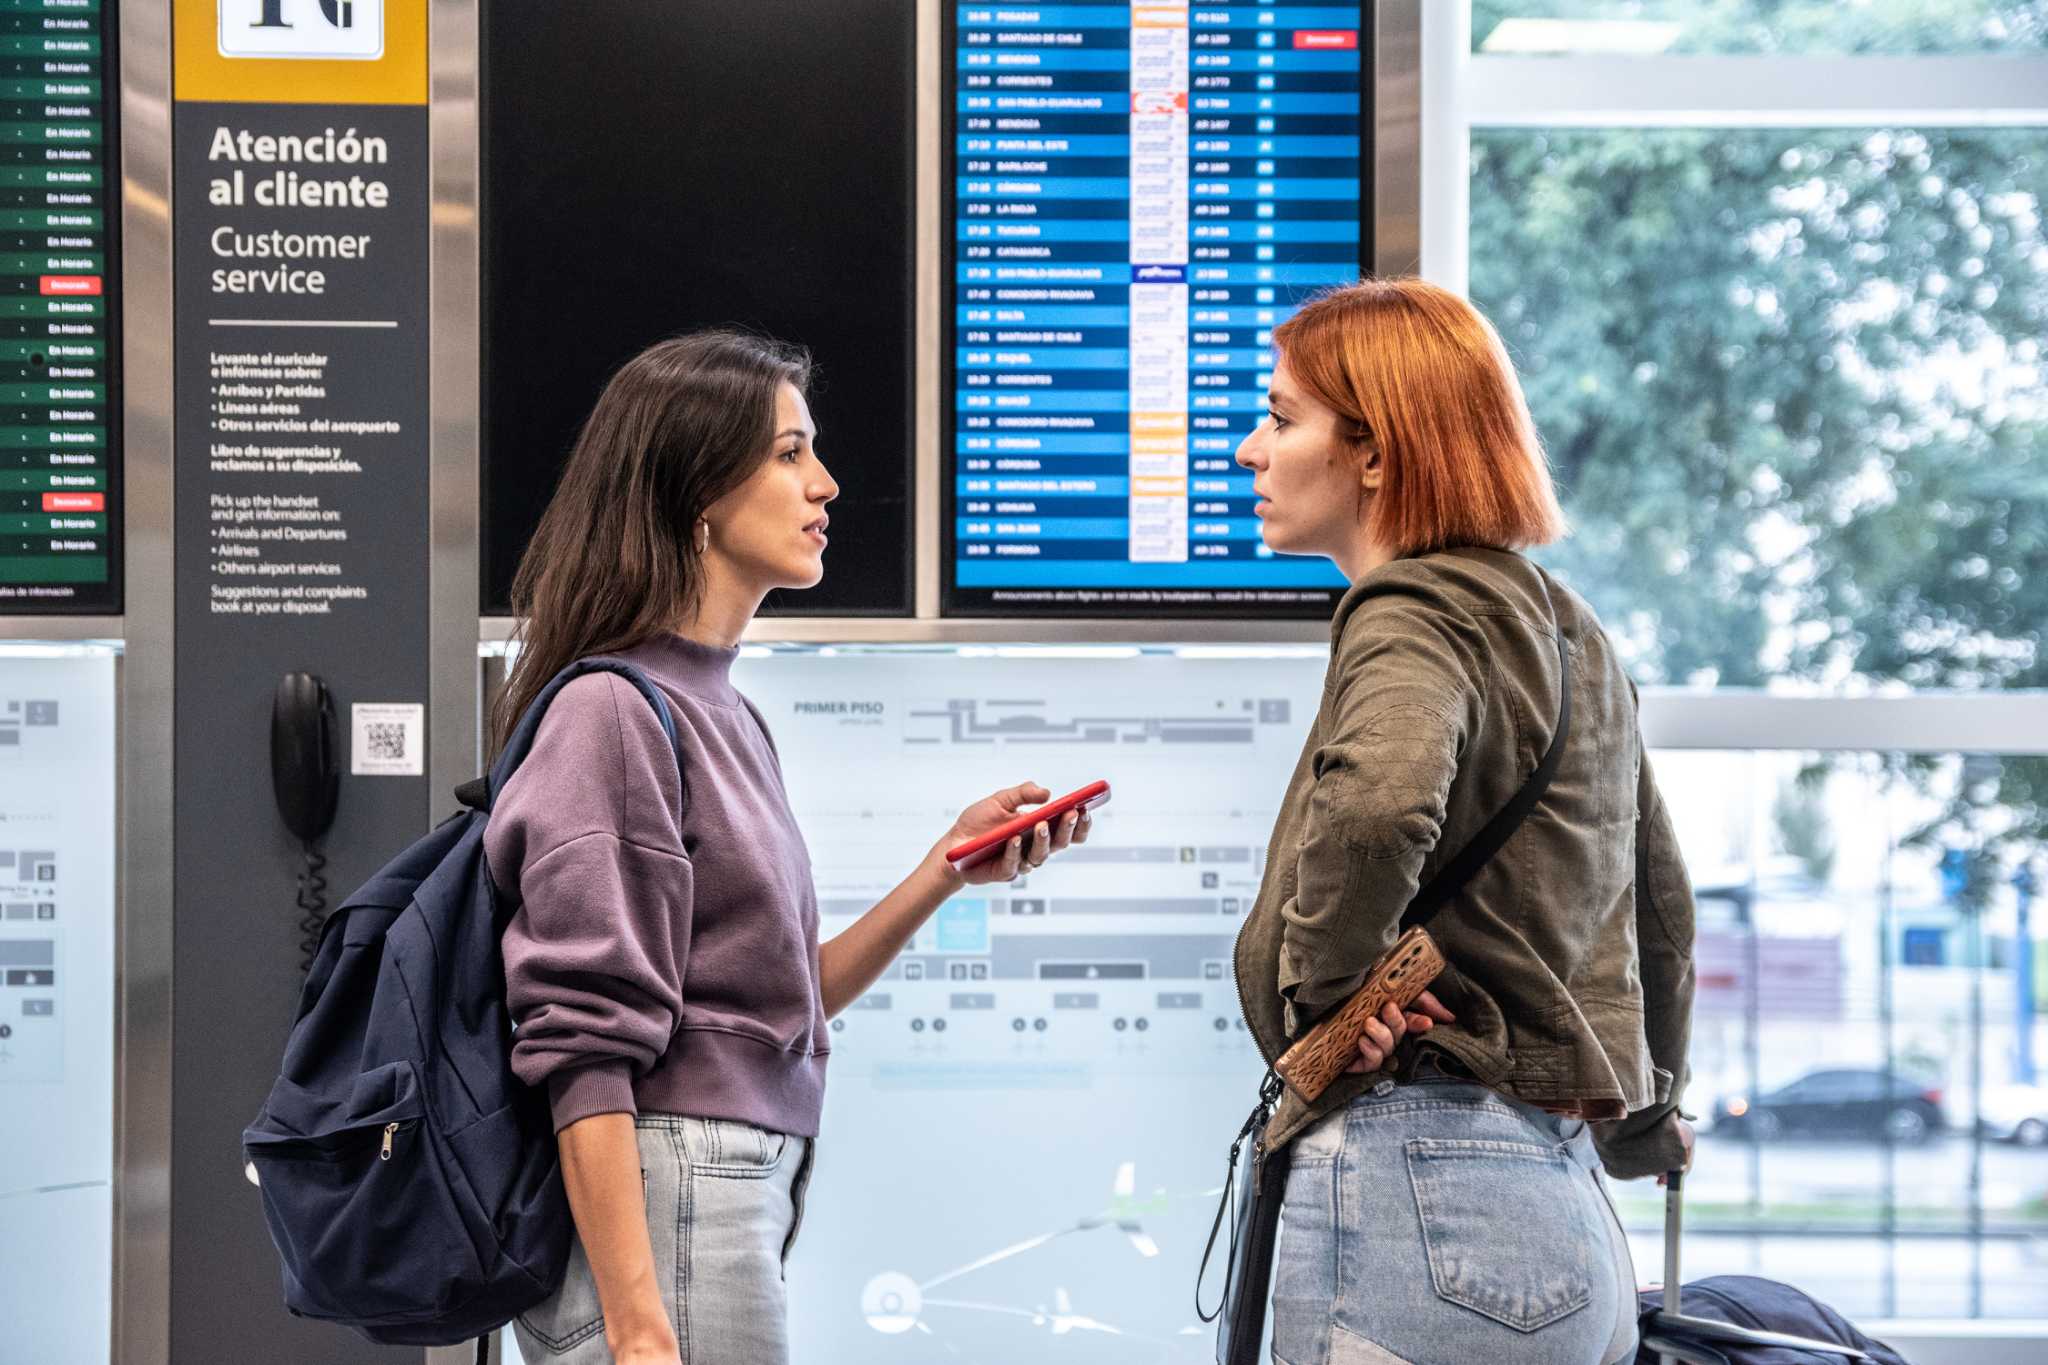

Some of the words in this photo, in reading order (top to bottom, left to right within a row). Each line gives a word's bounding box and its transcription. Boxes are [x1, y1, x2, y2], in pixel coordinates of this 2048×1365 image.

[43, 19, 57, 29] En
[56, 19, 89, 29] Horario
[44, 40, 57, 50] En
[57, 41, 90, 51] Horario
[44, 62, 57, 72] En
[57, 62, 90, 73] Horario
[45, 84, 58, 94] En
[57, 84, 90, 94] Horario
[45, 106, 58, 116] En
[58, 106, 91, 116] Horario
[45, 128, 58, 138] En
[58, 128, 91, 138] Horario
[209, 127, 387, 163] Atención
[46, 149, 58, 160] En
[59, 149, 91, 160] Horario
[46, 171, 59, 182] En
[59, 172, 92, 182] Horario
[209, 170, 244, 205] al
[254, 170, 389, 207] cliente
[46, 193, 59, 203] En
[59, 194, 92, 203] Horario
[47, 215, 60, 225] En
[60, 216, 92, 225] Horario
[47, 237, 60, 247] En
[60, 237, 93, 247] Horario
[211, 226, 371, 258] Customer
[47, 258, 60, 268] En
[60, 259, 93, 269] Horario
[212, 263, 325, 294] service
[48, 302, 61, 312] En
[61, 302, 94, 312] Horario
[48, 324, 61, 334] En
[61, 324, 94, 334] Horario
[48, 345, 62, 356] En
[62, 346, 94, 356] Horario
[210, 352, 259, 365] Levante
[260, 352, 273, 365] el
[273, 352, 328, 366] auricular
[49, 367, 62, 377] En
[62, 367, 95, 377] Horario
[211, 368, 220, 378] e
[221, 366, 283, 379] infórmese
[284, 366, 322, 379] sobre:
[49, 388, 62, 399] En
[62, 389, 95, 399] Horario
[218, 384, 264, 397] Arribos
[265, 387, 274, 400] y
[275, 384, 326, 398] Partidas
[218, 401, 258, 414] Líneas
[259, 402, 300, 415] aéreas
[49, 410, 62, 420] En
[62, 410, 95, 420] Horario
[218, 418, 253, 432] Otros
[255, 419, 308, 432] servicios
[309, 419, 330, 432] del
[331, 421, 400, 435] aeropuerto
[49, 432, 63, 442] En
[62, 432, 96, 442] Horario
[211, 444, 243, 458] Libro
[244, 444, 261, 457] de
[262, 445, 332, 460] sugerencias
[332, 448, 341, 460] y
[50, 454, 63, 464] En
[62, 454, 96, 464] Horario
[211, 458, 265, 471] reclamos
[266, 461, 275, 472] a
[276, 461, 291, 472] su
[291, 458, 362, 474] disposición.
[50, 475, 63, 486] En
[63, 476, 96, 485] Horario
[211, 494, 234, 507] Pick
[235, 497, 252, 508] up
[252, 494, 272, 507] the
[273, 495, 318, 507] handset
[211, 508, 234, 520] and
[235, 509, 254, 523] get
[255, 508, 321, 521] information
[322, 511, 340, 521] on:
[50, 518, 63, 529] En
[63, 519, 96, 529] Horario
[218, 526, 260, 539] Arrivals
[260, 527, 283, 540] and
[284, 527, 347, 541] Departures
[51, 540, 63, 550] En
[63, 540, 96, 550] Horario
[218, 544, 260, 557] Airlines
[218, 561, 257, 574] Others
[257, 562, 296, 577] airport
[297, 563, 341, 575] services
[211, 584, 280, 600] Suggestions
[281, 585, 304, 598] and
[305, 585, 367, 600] complaints
[211, 599, 240, 613] book
[242, 602, 254, 613] at
[255, 602, 281, 615] your
[282, 599, 333, 615] disposal.
[794, 702, 847, 714] PRIMER
[850, 702, 884, 714] PISO
